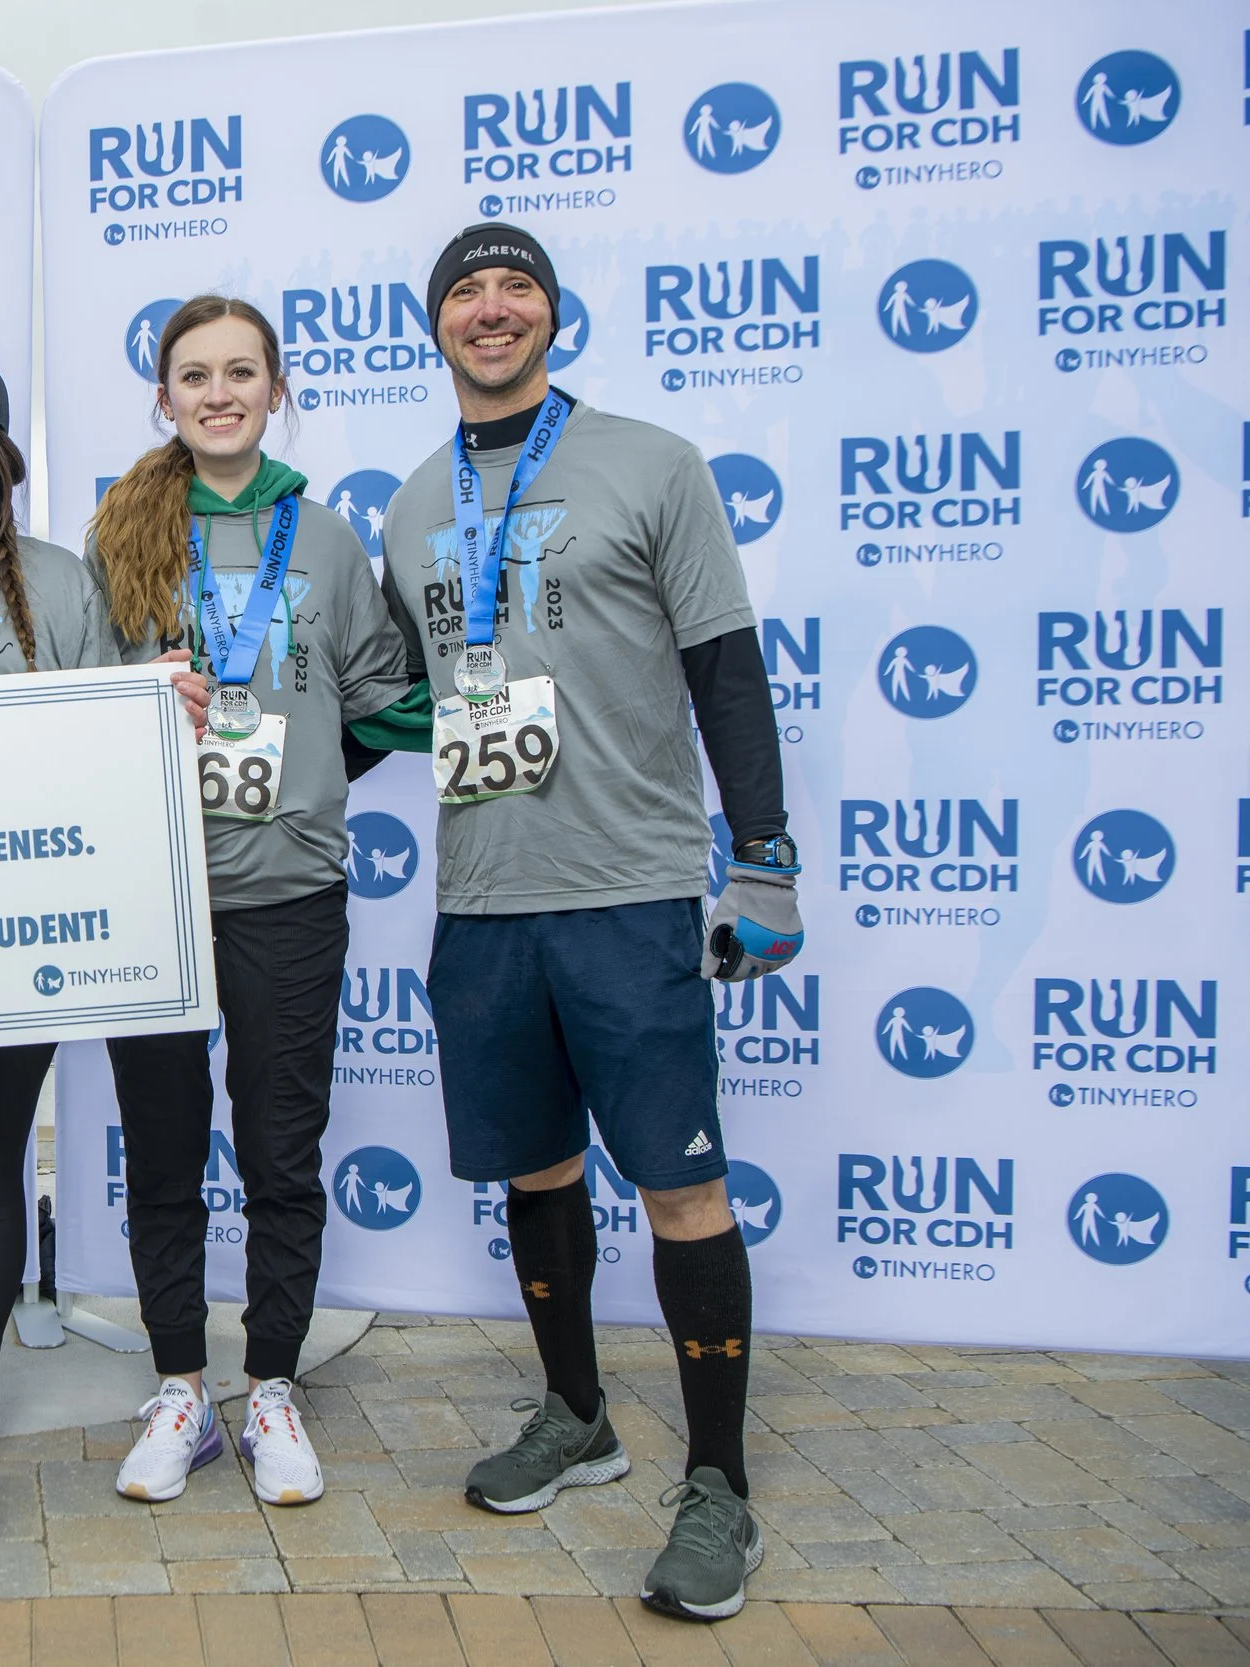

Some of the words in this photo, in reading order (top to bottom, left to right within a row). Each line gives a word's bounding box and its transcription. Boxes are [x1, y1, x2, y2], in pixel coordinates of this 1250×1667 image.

[839, 48, 1019, 119] RUN
[464, 81, 631, 150] RUN
[90, 115, 241, 181] RUN
[840, 122, 920, 154] FOR
[931, 114, 1020, 147] CDH
[465, 153, 539, 184] FOR
[549, 144, 631, 176] CDH
[884, 160, 1003, 185] TINYHERO
[90, 183, 158, 213] FOR
[167, 176, 242, 206] CDH
[506, 189, 615, 213] TINYHERO
[128, 218, 227, 241] TINYHERO
[1039, 230, 1226, 300] RUN
[646, 255, 819, 322] RUN
[1039, 304, 1123, 336] FOR
[1134, 298, 1226, 331] CDH
[646, 326, 724, 356] FOR
[734, 320, 820, 352] CDH
[283, 348, 355, 376] FOR
[364, 343, 443, 372] CDH
[1085, 345, 1207, 368] TINYHERO
[689, 365, 803, 388] TINYHERO
[323, 385, 428, 407] TINYHERO
[543, 398, 563, 428] FOR
[527, 428, 551, 462] CDH
[841, 431, 1020, 496] RUN
[458, 467, 474, 504] CDH
[279, 504, 293, 530] CDH
[841, 501, 921, 530] FOR
[932, 497, 1020, 527] CDH
[271, 530, 289, 558] FOR
[885, 542, 1003, 563] TINYHERO
[260, 557, 282, 591] RUN
[546, 578, 564, 630] 2023
[205, 602, 230, 658] TINYHERO
[428, 616, 463, 638] FOR
[1038, 608, 1223, 670] RUN
[295, 645, 309, 693] 2023
[467, 651, 492, 662] RUN
[220, 690, 248, 701] RUN
[1038, 677, 1121, 706] FOR
[1131, 675, 1222, 705] CDH
[470, 709, 488, 721] FOR
[490, 704, 511, 716] CDH
[1082, 721, 1204, 740] TINYHERO
[440, 724, 554, 798] 259
[197, 752, 272, 815] 68
[841, 799, 1018, 858] RUN
[840, 864, 920, 892] FOR
[930, 864, 1018, 892] CDH
[884, 908, 1000, 926] TINYHERO
[68, 964, 159, 987] TINYHERO
[1034, 978, 1217, 1039] RUN
[735, 1036, 819, 1065] CDH
[1034, 1043, 1116, 1071] FOR
[1126, 1044, 1216, 1074] CDH
[333, 1067, 435, 1086] TINYHERO
[1078, 1087, 1198, 1107] TINYHERO
[838, 1154, 1014, 1215] RUN
[838, 1216, 917, 1245] FOR
[927, 1219, 1013, 1249] CDH
[881, 1260, 995, 1281] TINYHERO
